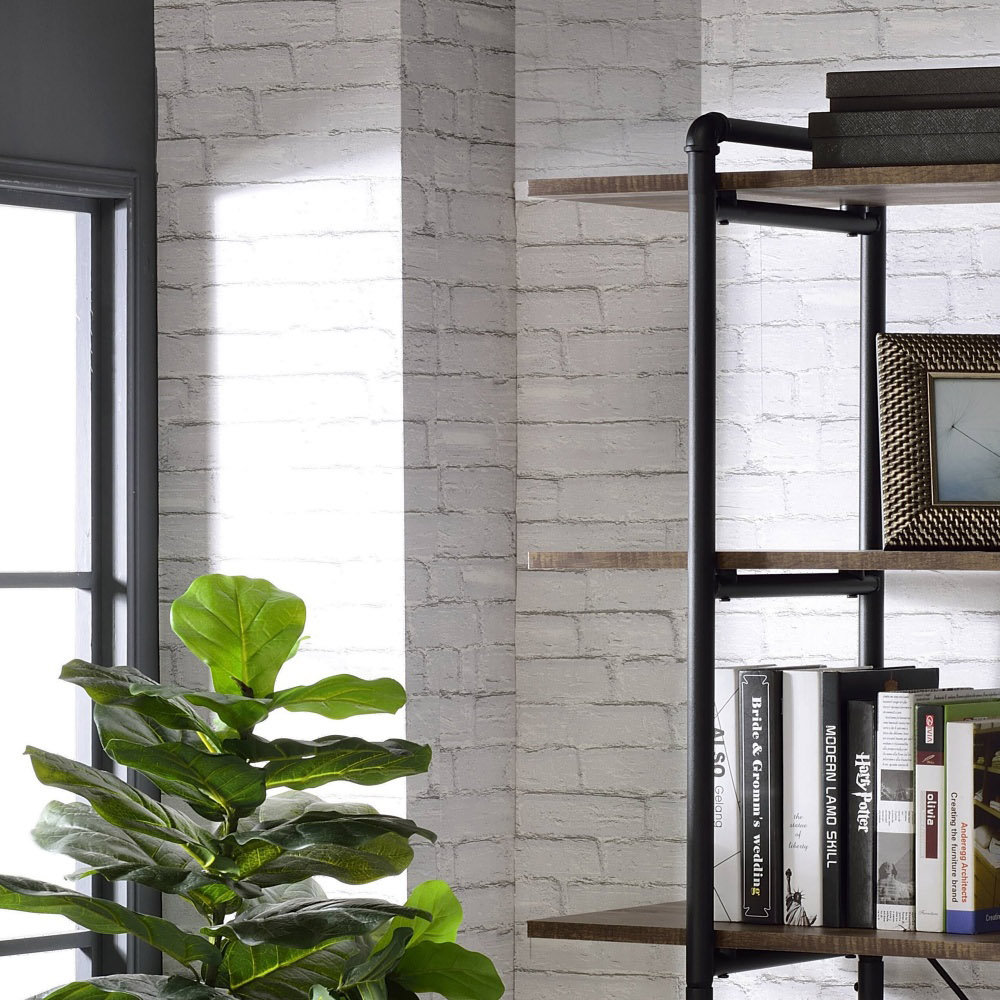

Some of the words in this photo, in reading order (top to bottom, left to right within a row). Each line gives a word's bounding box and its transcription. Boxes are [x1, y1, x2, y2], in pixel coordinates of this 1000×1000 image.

[751, 696, 763, 740] Bride
[752, 742, 763, 756] &
[825, 725, 837, 782] MODERN
[855, 752, 872, 791] Harry
[851, 792, 873, 833] Potter
[927, 793, 937, 826] olivia
[950, 792, 958, 826] Creating
[826, 830, 837, 869] SKILL
[960, 822, 968, 860] Anderegg
[751, 834, 764, 896] wedding
[961, 862, 969, 903] Architects
